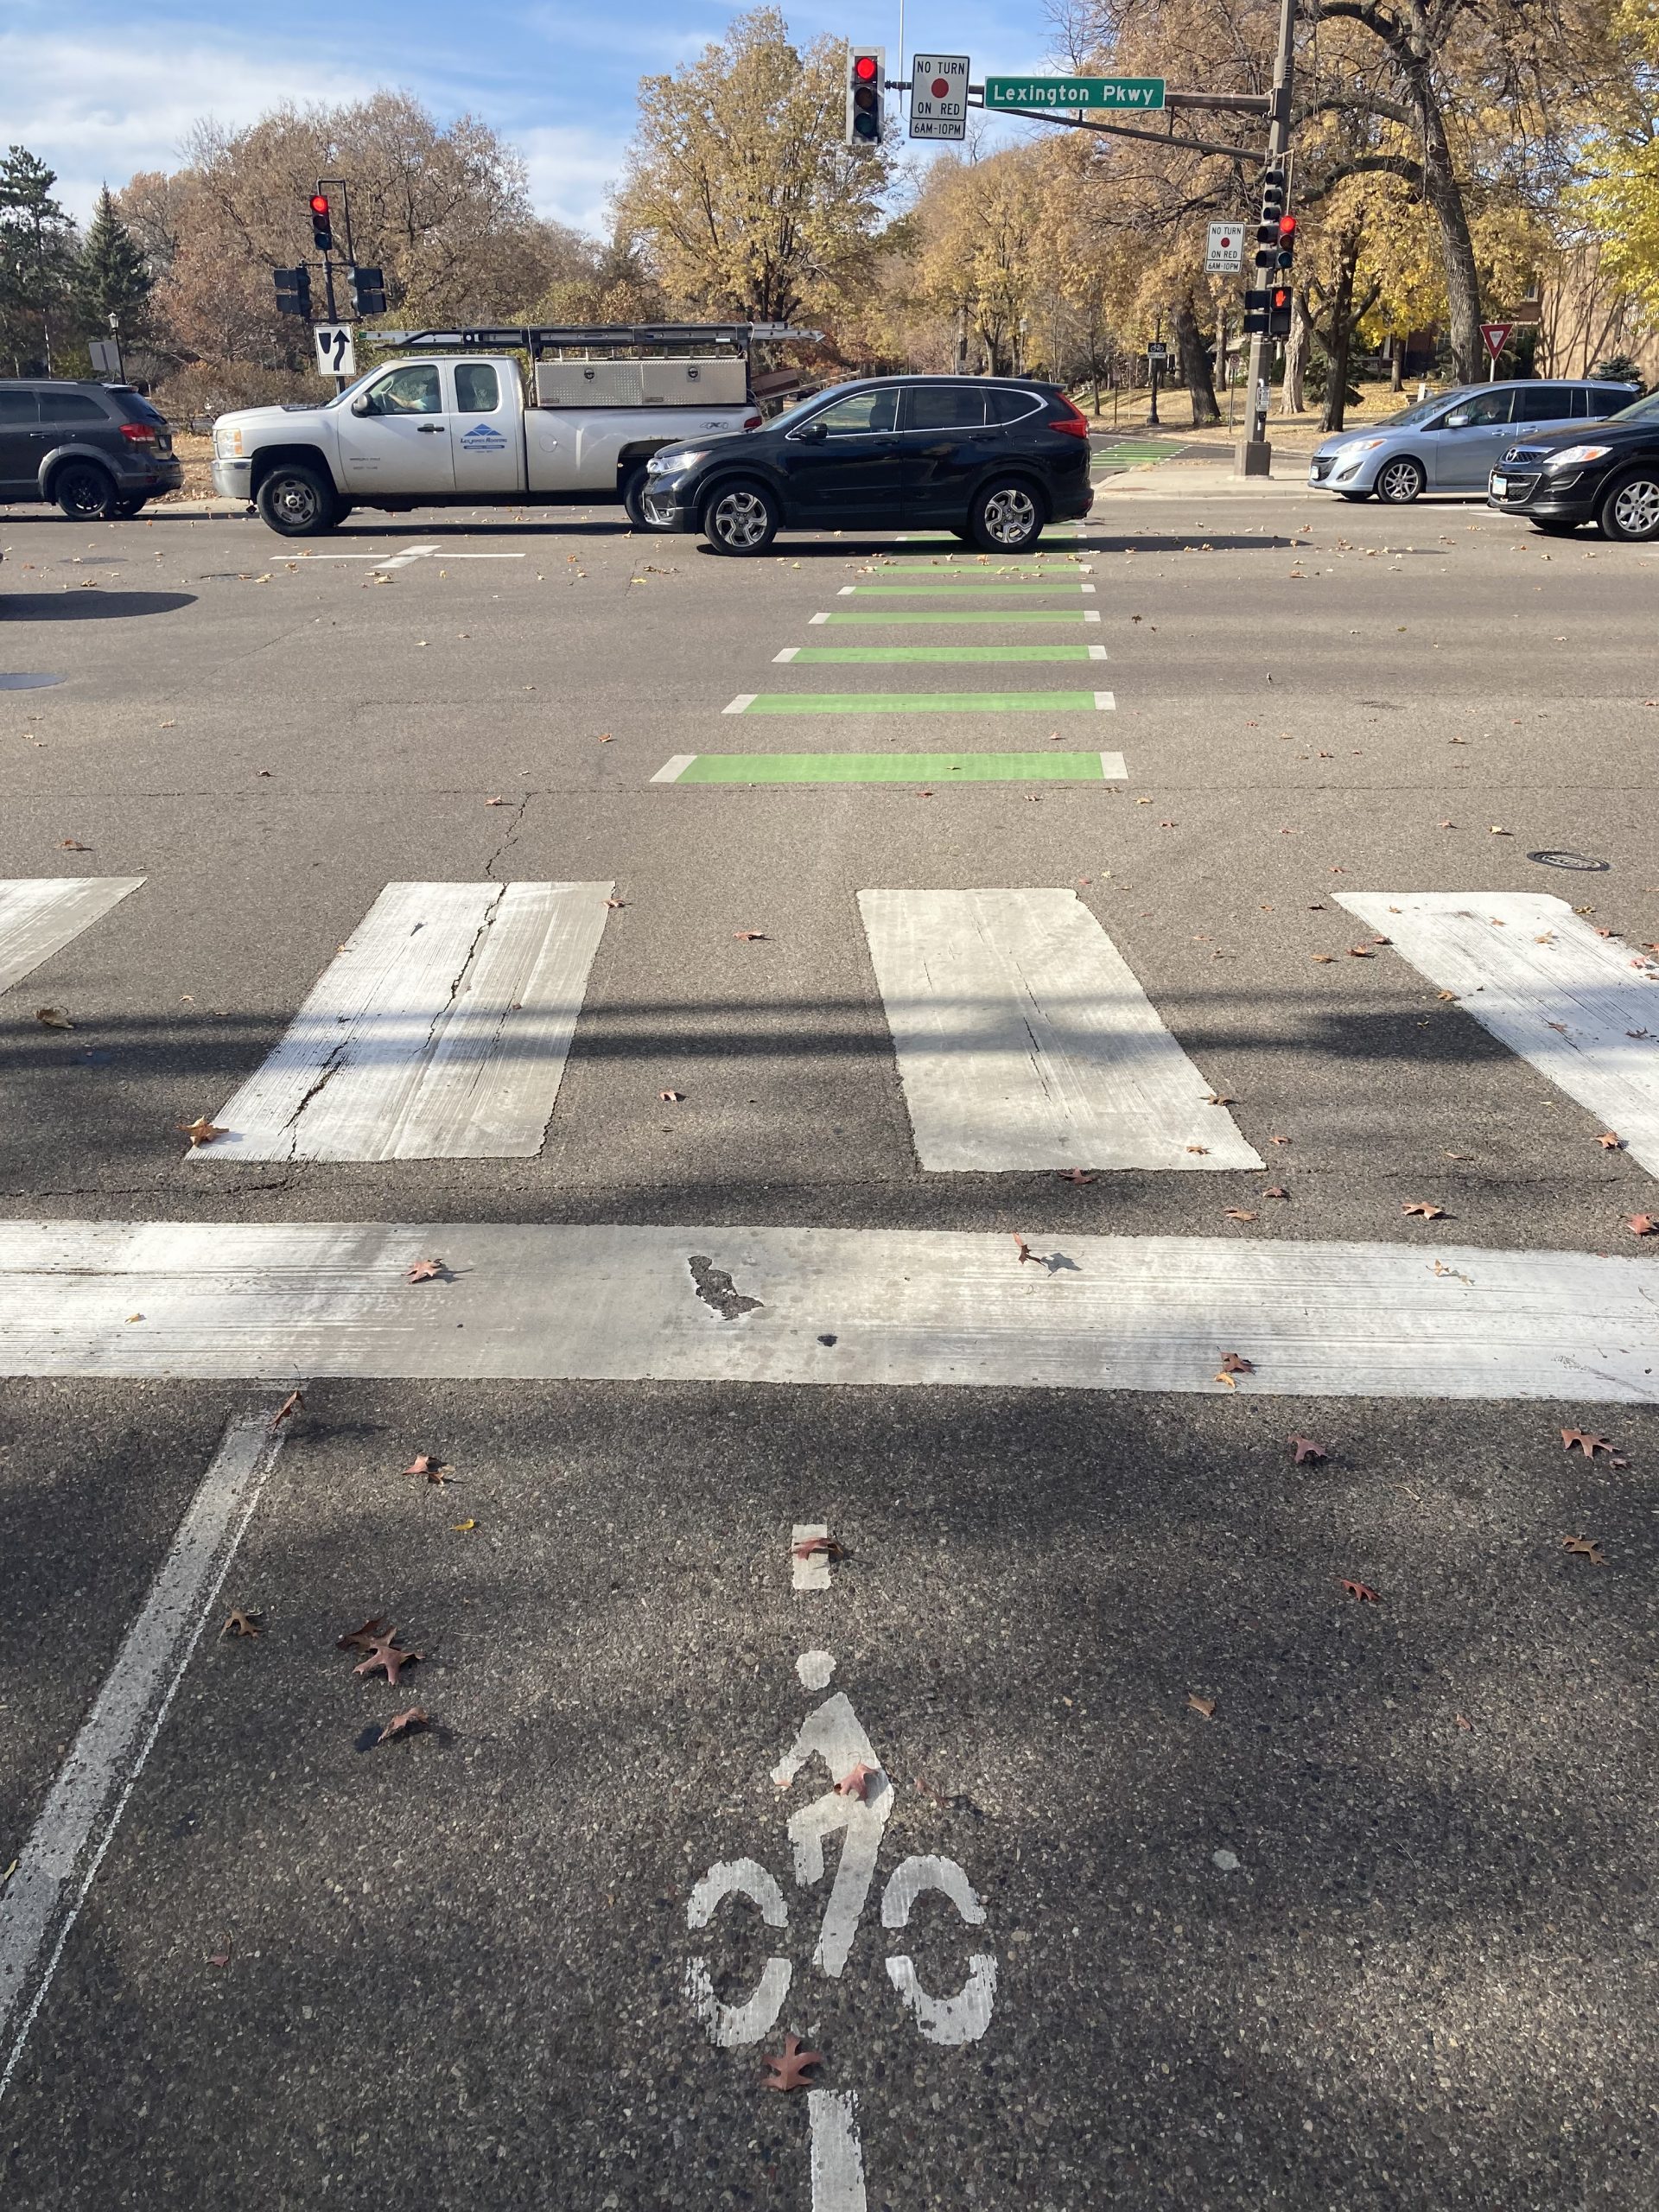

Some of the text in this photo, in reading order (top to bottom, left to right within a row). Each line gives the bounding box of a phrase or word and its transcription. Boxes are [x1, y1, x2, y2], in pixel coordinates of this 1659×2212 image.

[917, 61, 964, 75] NO TURN
[994, 85, 1154, 105] Lexington Pkwy
[918, 102, 960, 116] ON RED
[914, 123, 961, 135] 6AM-10PM
[1224, 226, 1241, 235] TURN
[1208, 262, 1239, 270] 6AM-10PM
